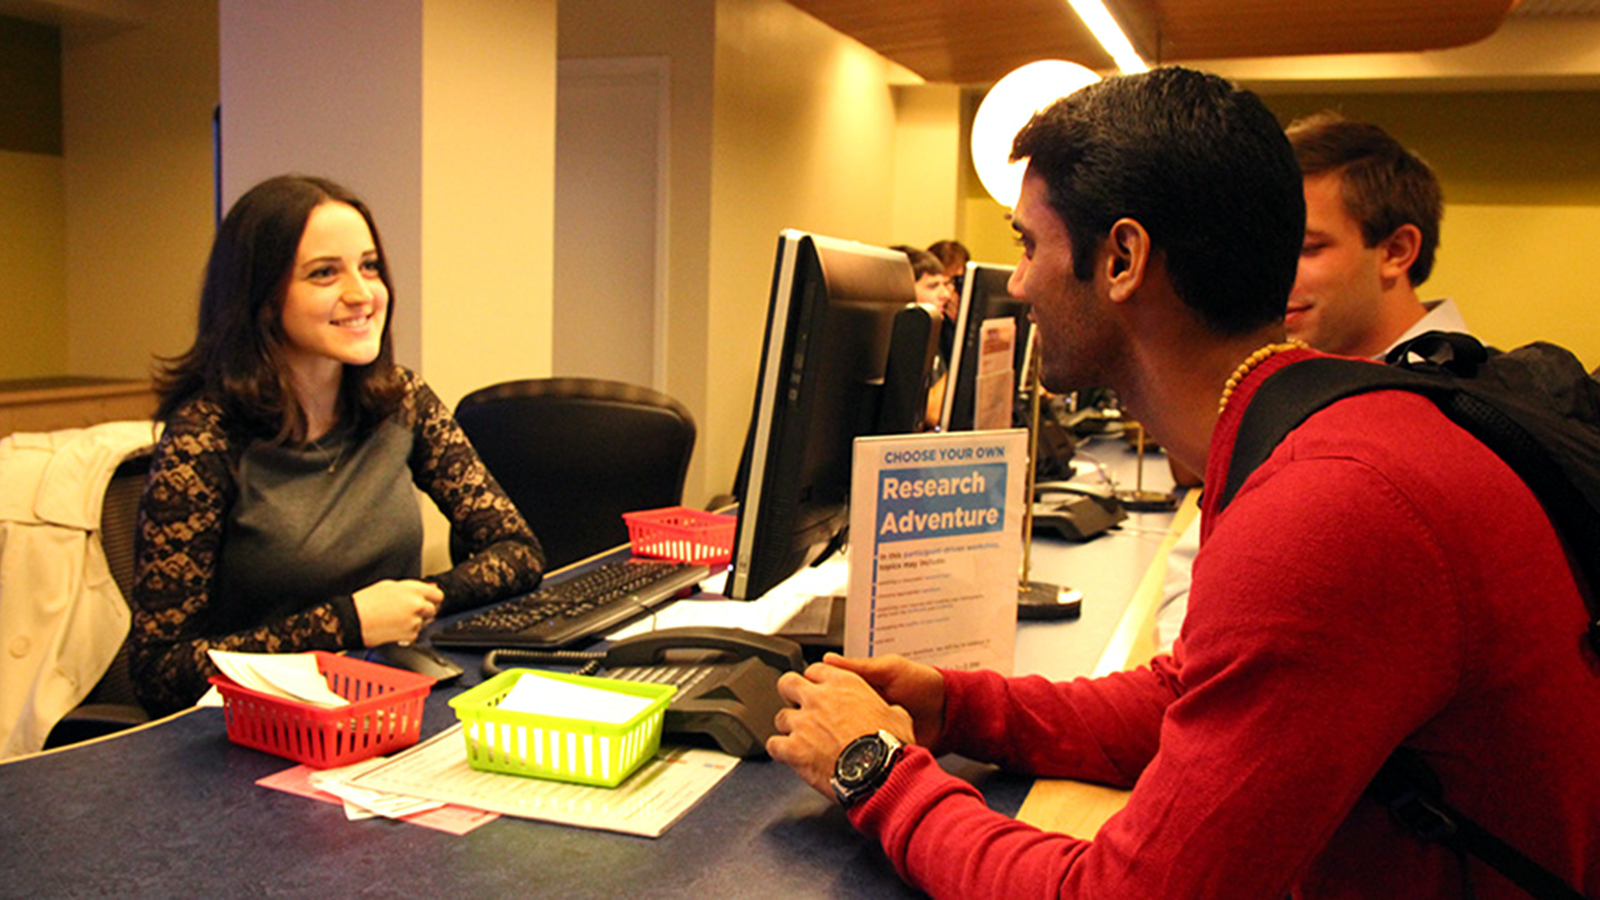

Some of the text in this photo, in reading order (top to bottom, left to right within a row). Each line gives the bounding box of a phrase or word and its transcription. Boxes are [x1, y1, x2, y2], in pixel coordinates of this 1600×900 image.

[884, 446, 1005, 464] CHOOSE YOUR OWN
[882, 471, 986, 500] Research
[879, 507, 999, 535] Adventure
